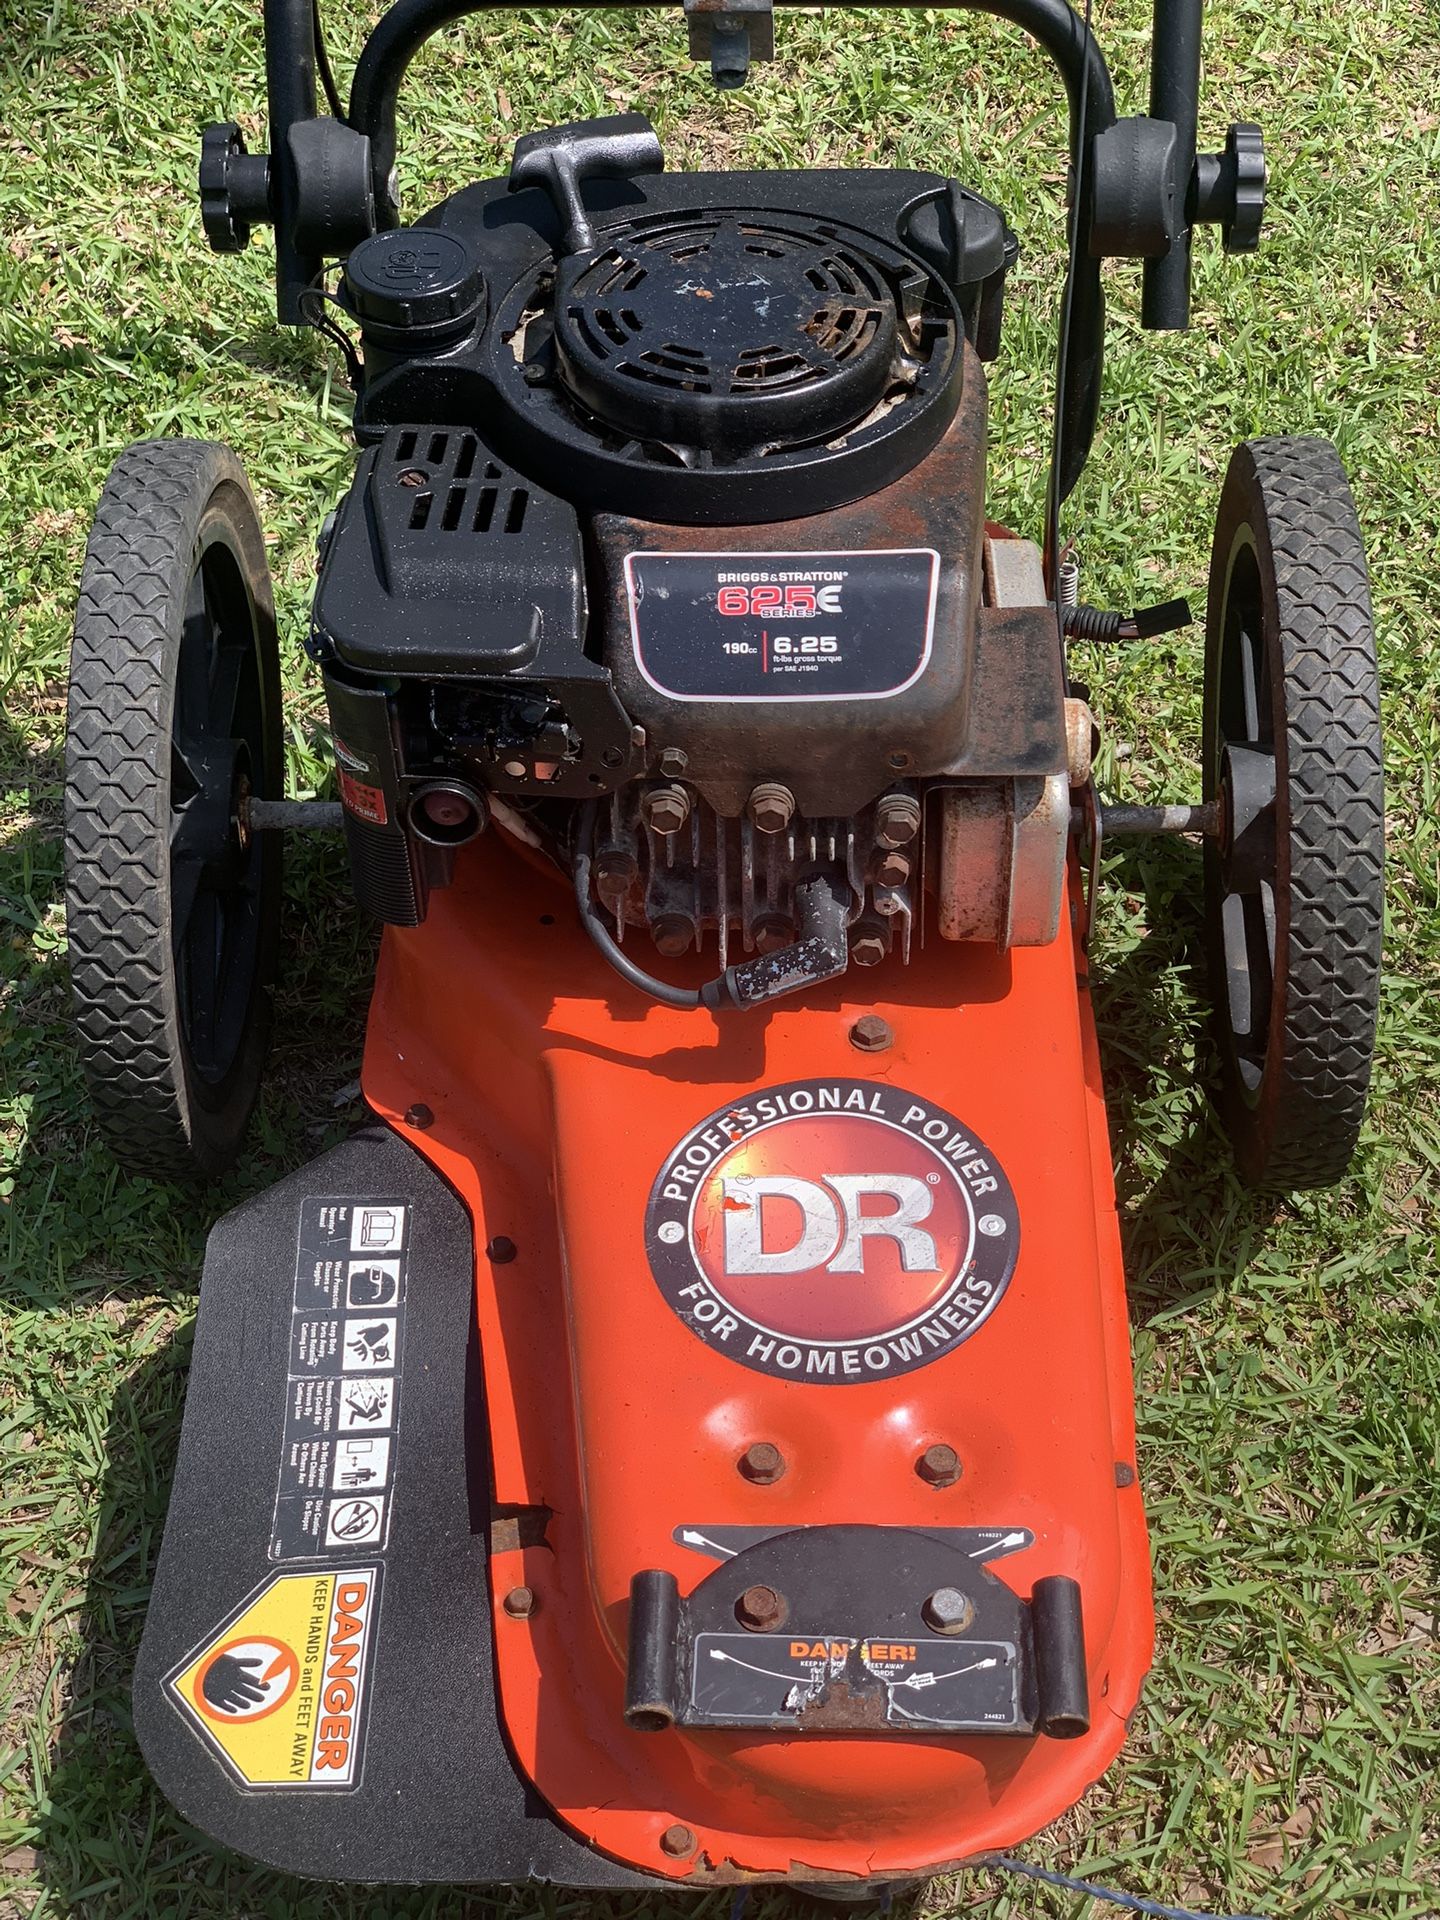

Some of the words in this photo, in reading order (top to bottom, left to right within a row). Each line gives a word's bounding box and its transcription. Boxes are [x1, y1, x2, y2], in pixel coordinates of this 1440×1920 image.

[760, 606, 816, 618] SERIES
[722, 642, 758, 654] 190cc
[773, 636, 838, 653] 6.25
[794, 656, 815, 664] gross
[817, 655, 843, 664] torque
[663, 1087, 887, 1202] PROFESSIONAL
[901, 1105, 998, 1197] POWER
[319, 1207, 327, 1227] Manual
[328, 1206, 337, 1235] Operator's
[339, 1206, 347, 1220] Read
[314, 1261, 323, 1286] Goggles
[324, 1261, 332, 1284] Glasses
[334, 1260, 342, 1277] Wear
[332, 1278, 341, 1309] Protective
[299, 1322, 308, 1345] Cutting
[310, 1322, 318, 1338] From
[320, 1321, 328, 1338] Parts
[329, 1321, 338, 1337] Keep
[678, 1282, 739, 1340] FOR
[747, 1275, 994, 1375] HOMEOWNERS
[299, 1346, 307, 1360] Line
[307, 1338, 317, 1366] Rotating
[318, 1340, 327, 1357] Away
[328, 1338, 337, 1355] Body
[294, 1382, 304, 1405] Cutting
[305, 1381, 314, 1406] Thrown
[316, 1381, 324, 1395] That
[325, 1380, 334, 1406] Remove
[295, 1406, 303, 1420] Line
[304, 1407, 312, 1416] By
[314, 1397, 323, 1415] Could
[313, 1416, 321, 1425] Be
[323, 1407, 332, 1431] Objects
[290, 1443, 299, 1466] Around
[301, 1442, 309, 1451] Or
[311, 1441, 320, 1460] When
[322, 1441, 330, 1450] Do
[300, 1451, 308, 1472] Others
[320, 1451, 329, 1463] Not
[298, 1473, 306, 1484] Are
[308, 1461, 318, 1487] Children
[318, 1464, 328, 1488] Operate
[305, 1500, 313, 1510] On
[315, 1500, 323, 1512] Use
[302, 1510, 312, 1531] Slopes
[312, 1513, 321, 1535] Caution
[312, 1579, 329, 1612] KEEP
[304, 1615, 324, 1664] HANDS
[789, 1641, 917, 1661] DANER!
[301, 1667, 313, 1692] and
[315, 1582, 368, 1770] DANGER
[295, 1696, 313, 1729] FEET
[289, 1733, 308, 1777] AWAY
